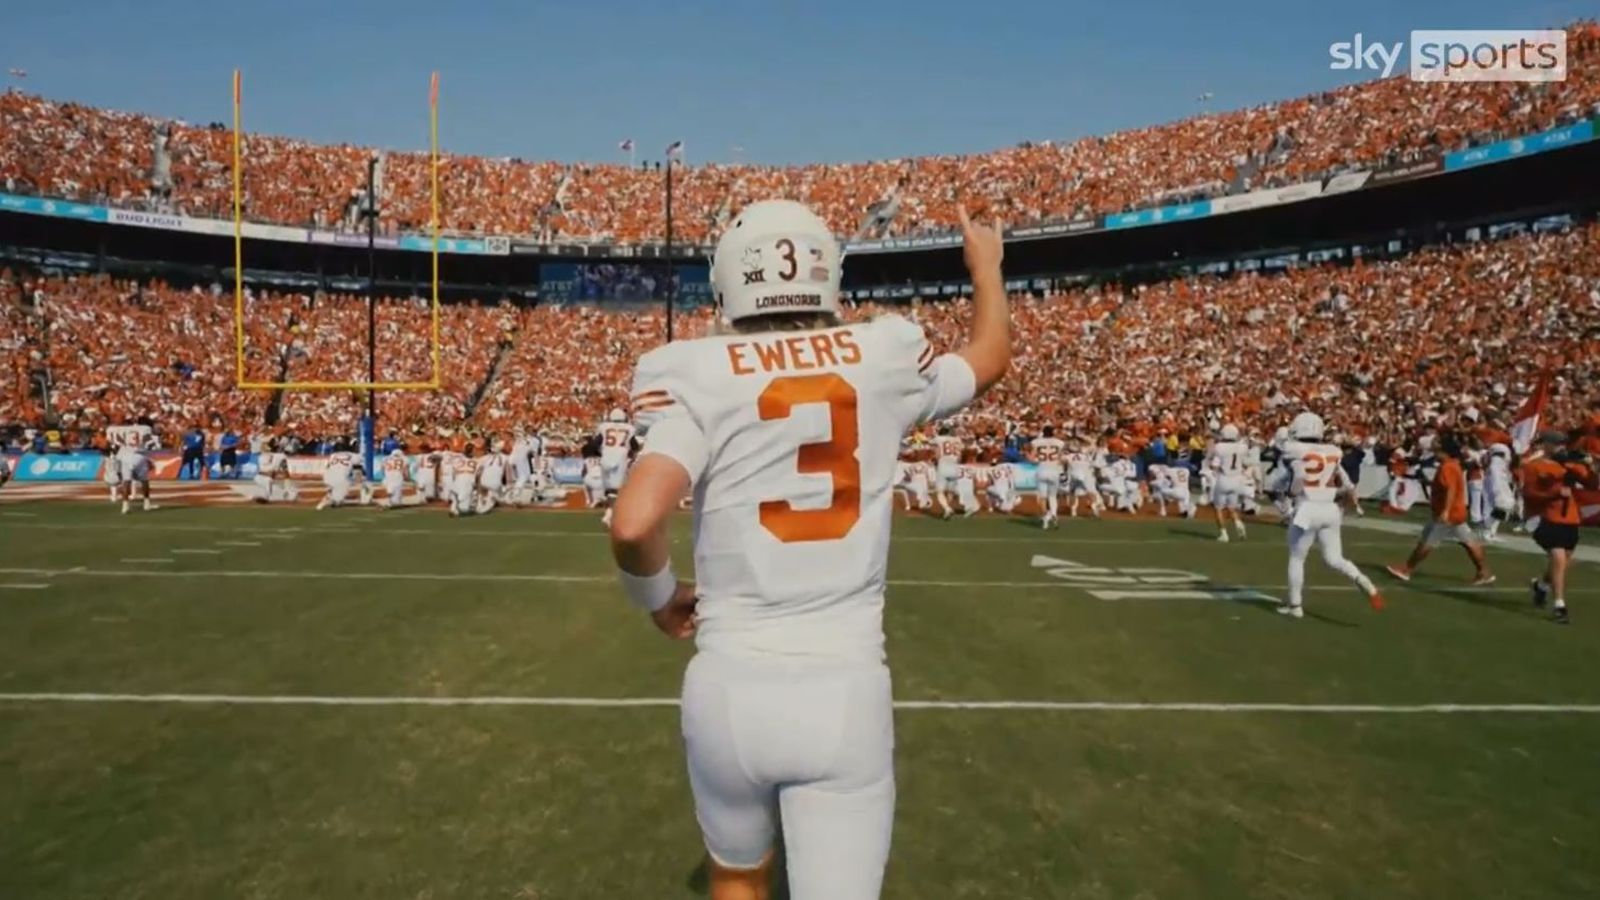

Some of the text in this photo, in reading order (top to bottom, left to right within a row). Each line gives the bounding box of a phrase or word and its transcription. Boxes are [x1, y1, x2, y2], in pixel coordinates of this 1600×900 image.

[775, 237, 798, 281] 3
[742, 267, 766, 285] XII
[755, 293, 822, 309] LONGHORNS
[727, 330, 862, 375] EWERS
[757, 372, 861, 543] 3
[1229, 452, 1238, 470] 1
